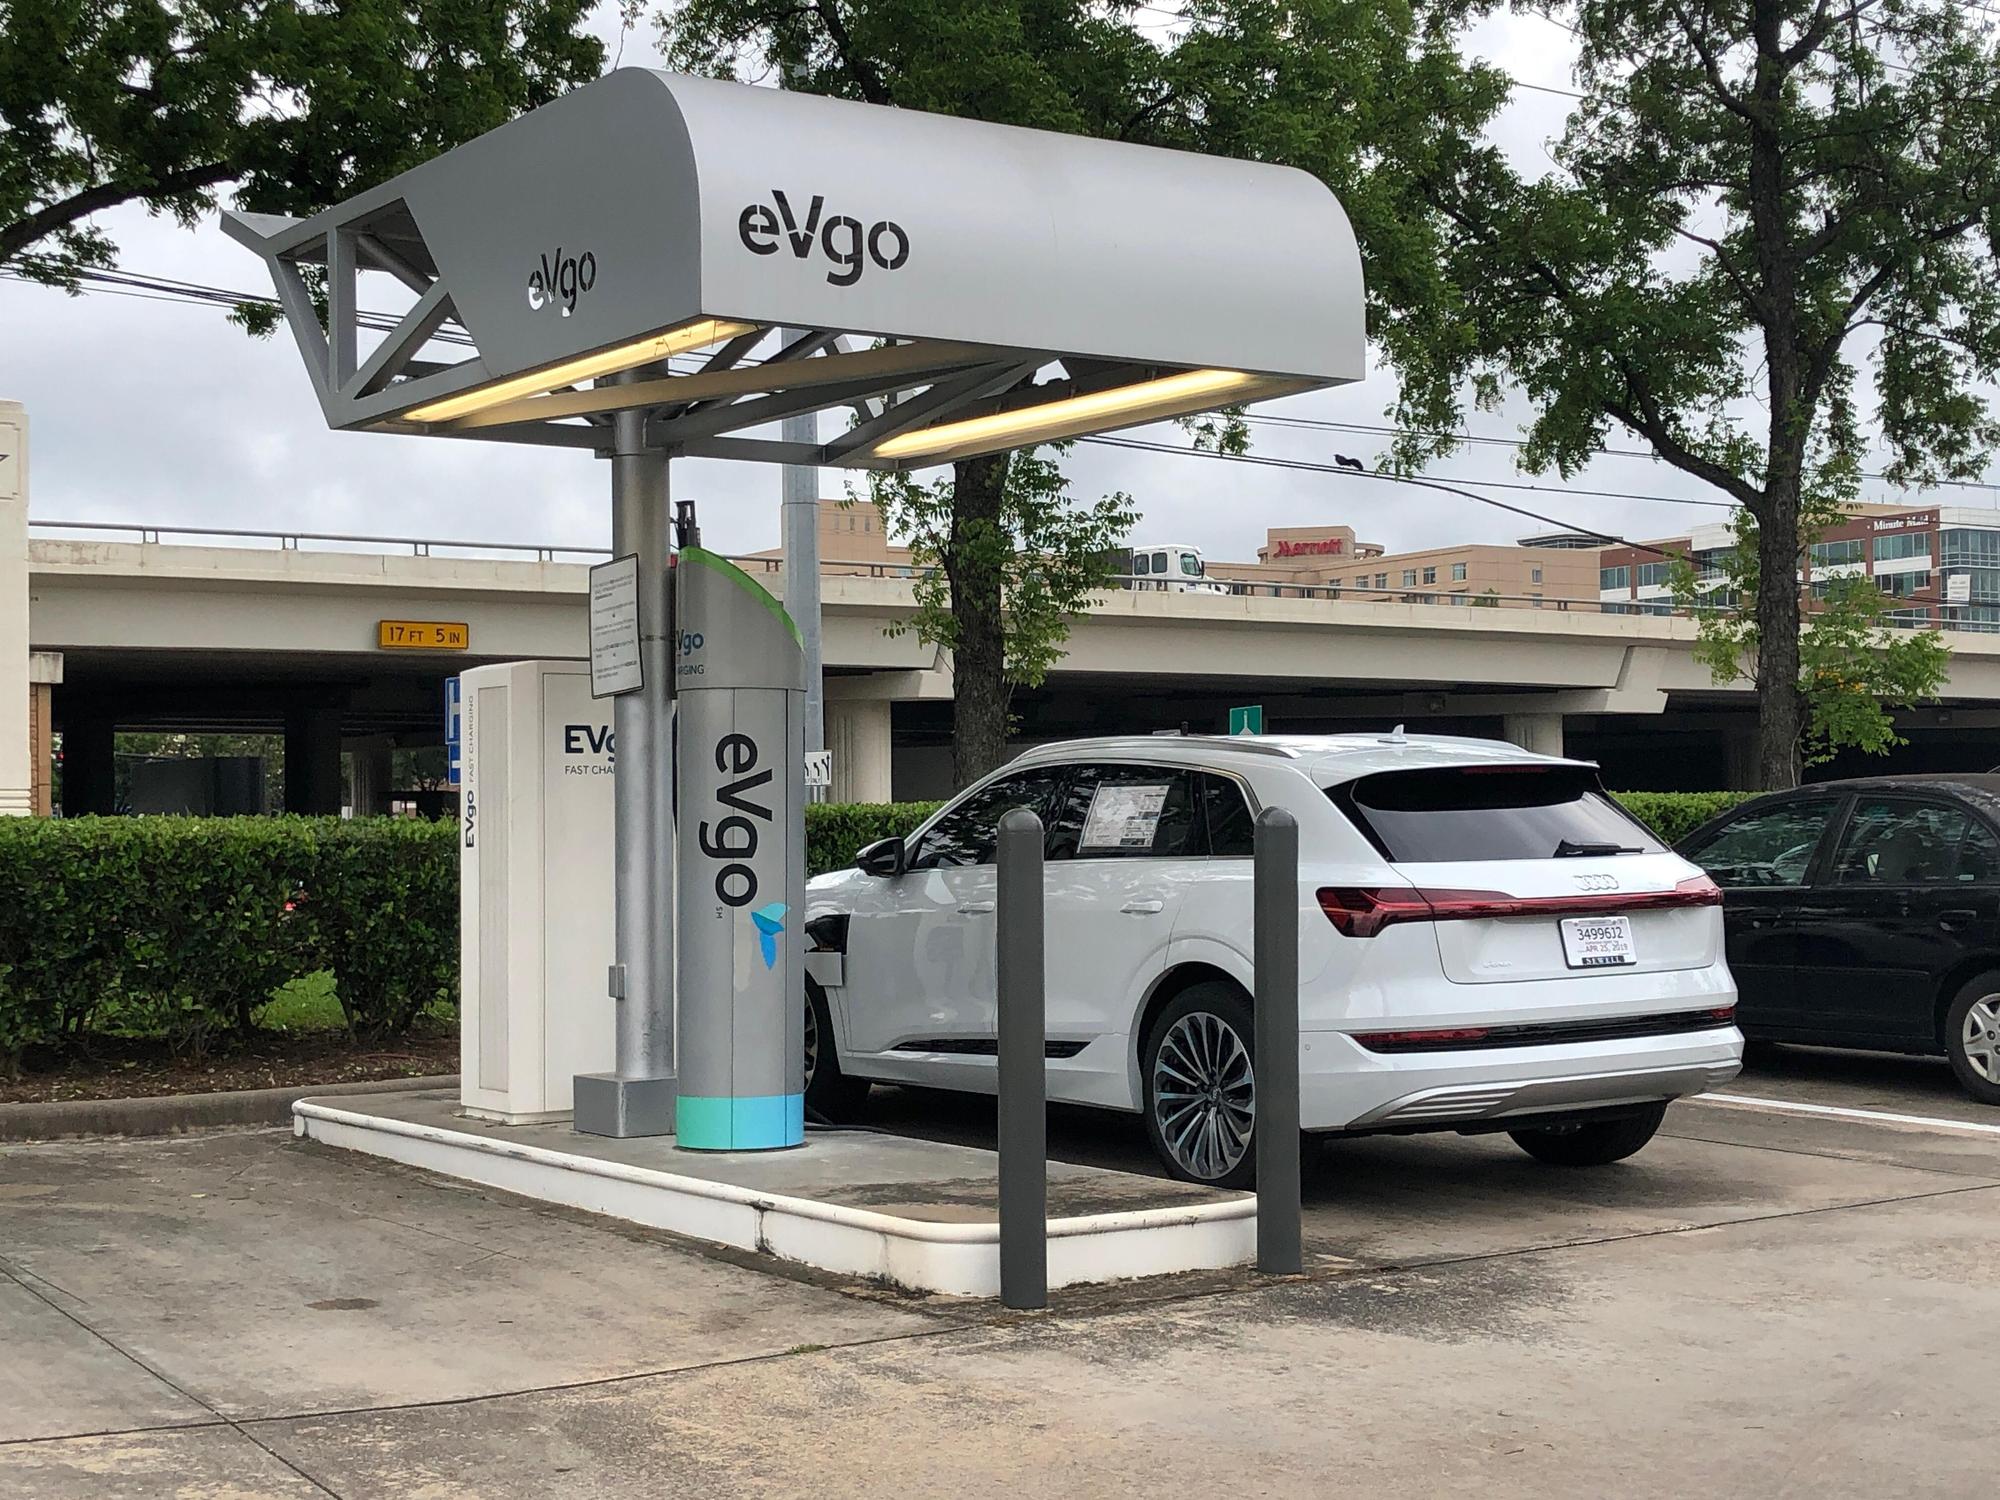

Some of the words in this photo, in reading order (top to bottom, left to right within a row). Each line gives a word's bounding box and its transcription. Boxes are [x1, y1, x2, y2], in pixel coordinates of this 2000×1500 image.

[739, 189, 910, 286] eVgo
[528, 247, 597, 317] eVgo
[1873, 520, 1904, 531] Minute
[1273, 538, 1343, 558] Marriott
[390, 627, 404, 641] 17
[410, 631, 424, 642] FT
[435, 628, 445, 643] 5
[449, 632, 460, 643] IN
[676, 629, 705, 657] Vgo
[467, 695, 475, 754] CHARGING
[565, 765, 589, 775] FAST
[465, 790, 477, 848] EVgo
[699, 733, 773, 907] eVgo
